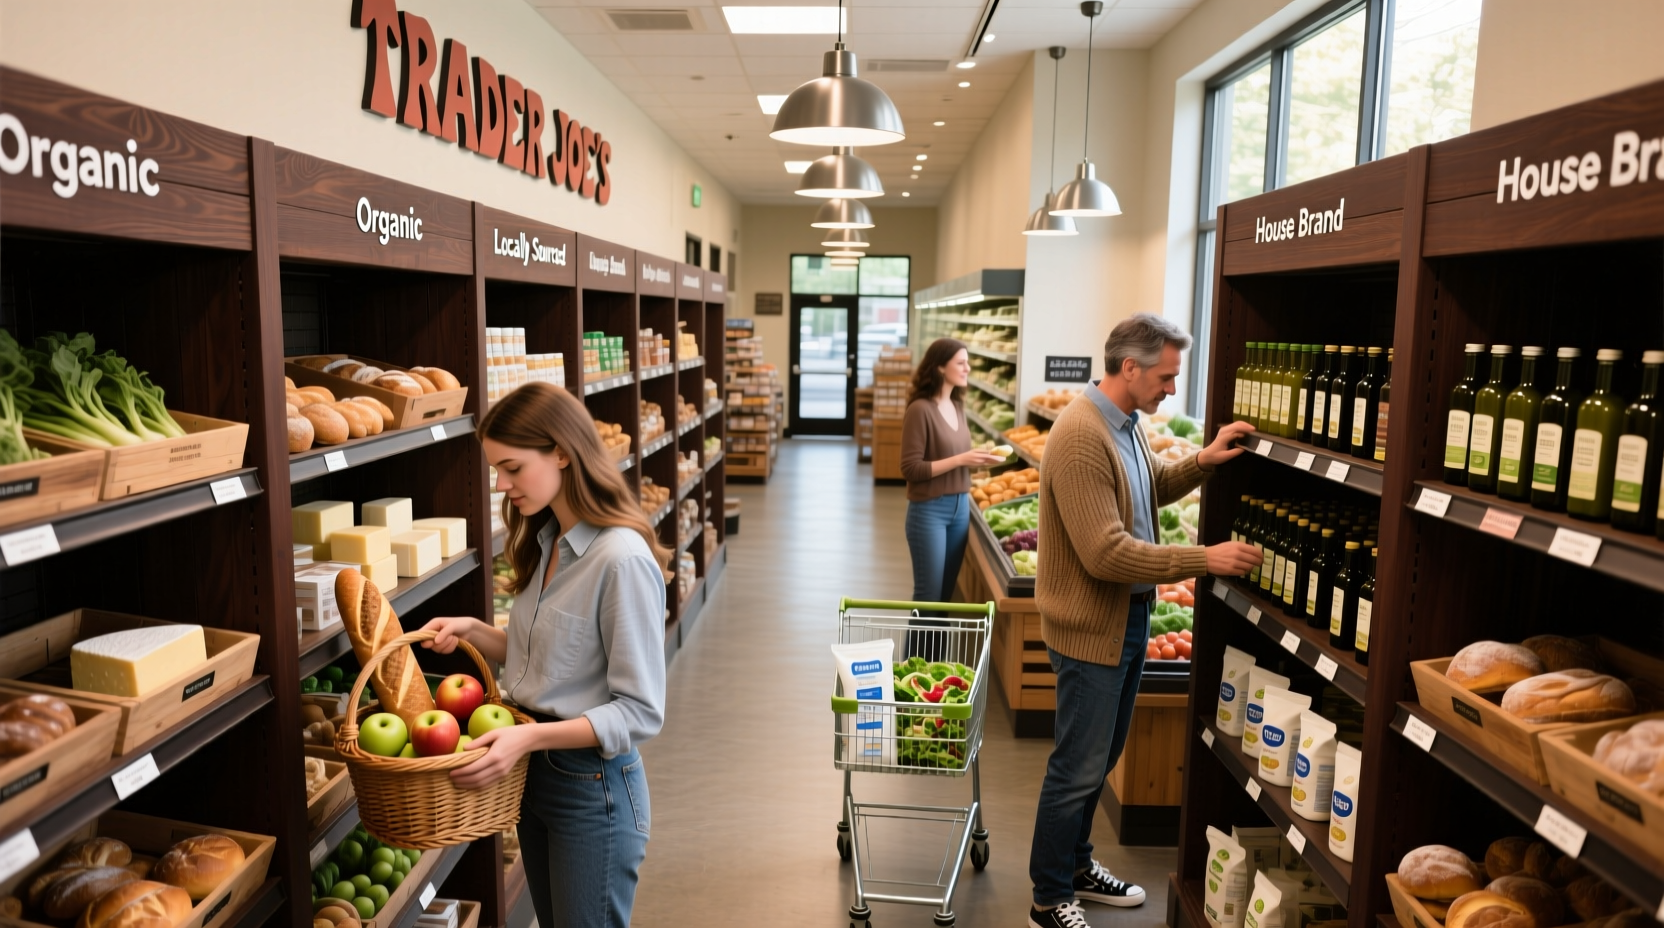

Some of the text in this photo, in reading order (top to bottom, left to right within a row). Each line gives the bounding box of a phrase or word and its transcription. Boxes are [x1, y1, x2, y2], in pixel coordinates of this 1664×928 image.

[351, 0, 611, 206] TRADER JOE'S
[0, 113, 160, 198] Organic
[1497, 151, 1601, 204] House
[356, 196, 423, 245] Organic
[1255, 197, 1345, 243] House Brand
[494, 228, 530, 266] Locally
